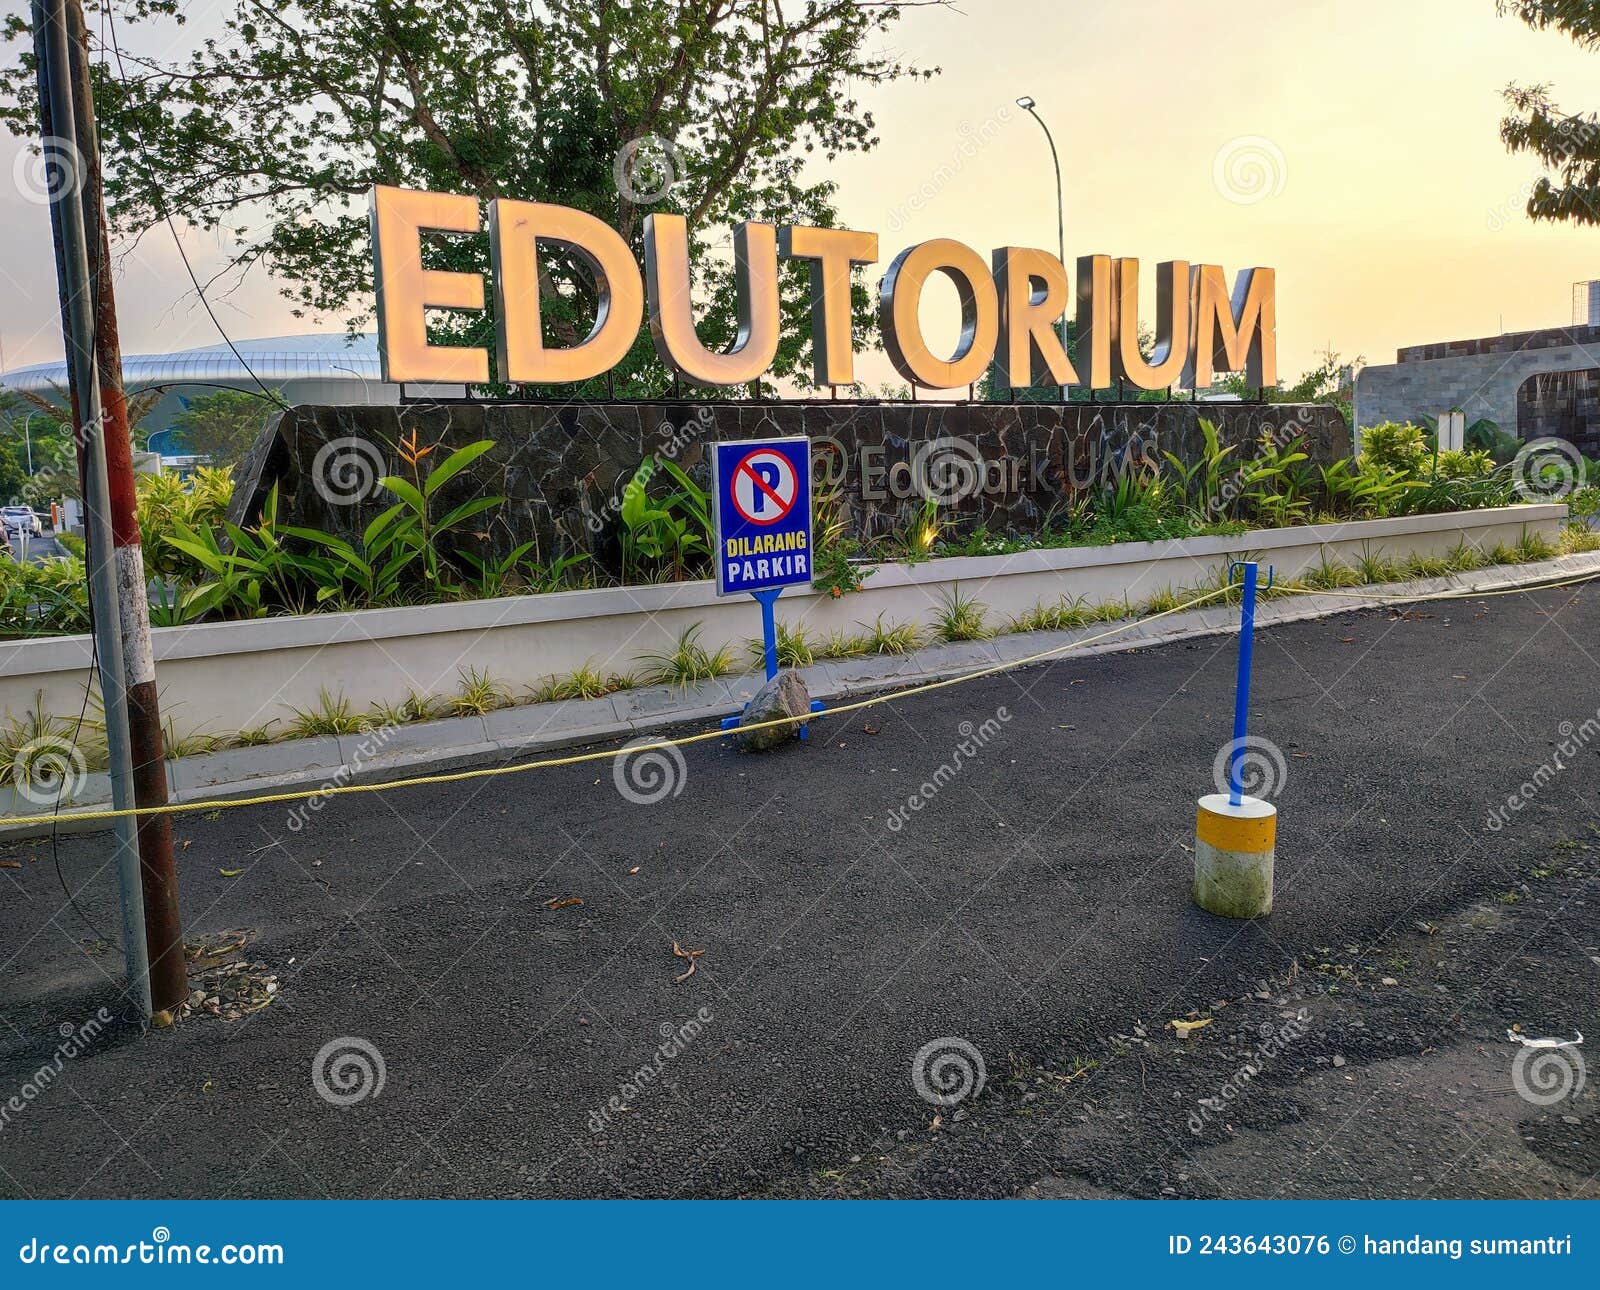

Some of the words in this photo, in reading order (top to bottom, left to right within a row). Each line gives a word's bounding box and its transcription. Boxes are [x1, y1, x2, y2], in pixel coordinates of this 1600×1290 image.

[371, 184, 1277, 390] EDUTORIUM
[727, 530, 807, 558] DILARANG
[728, 554, 807, 583] PARKIR
